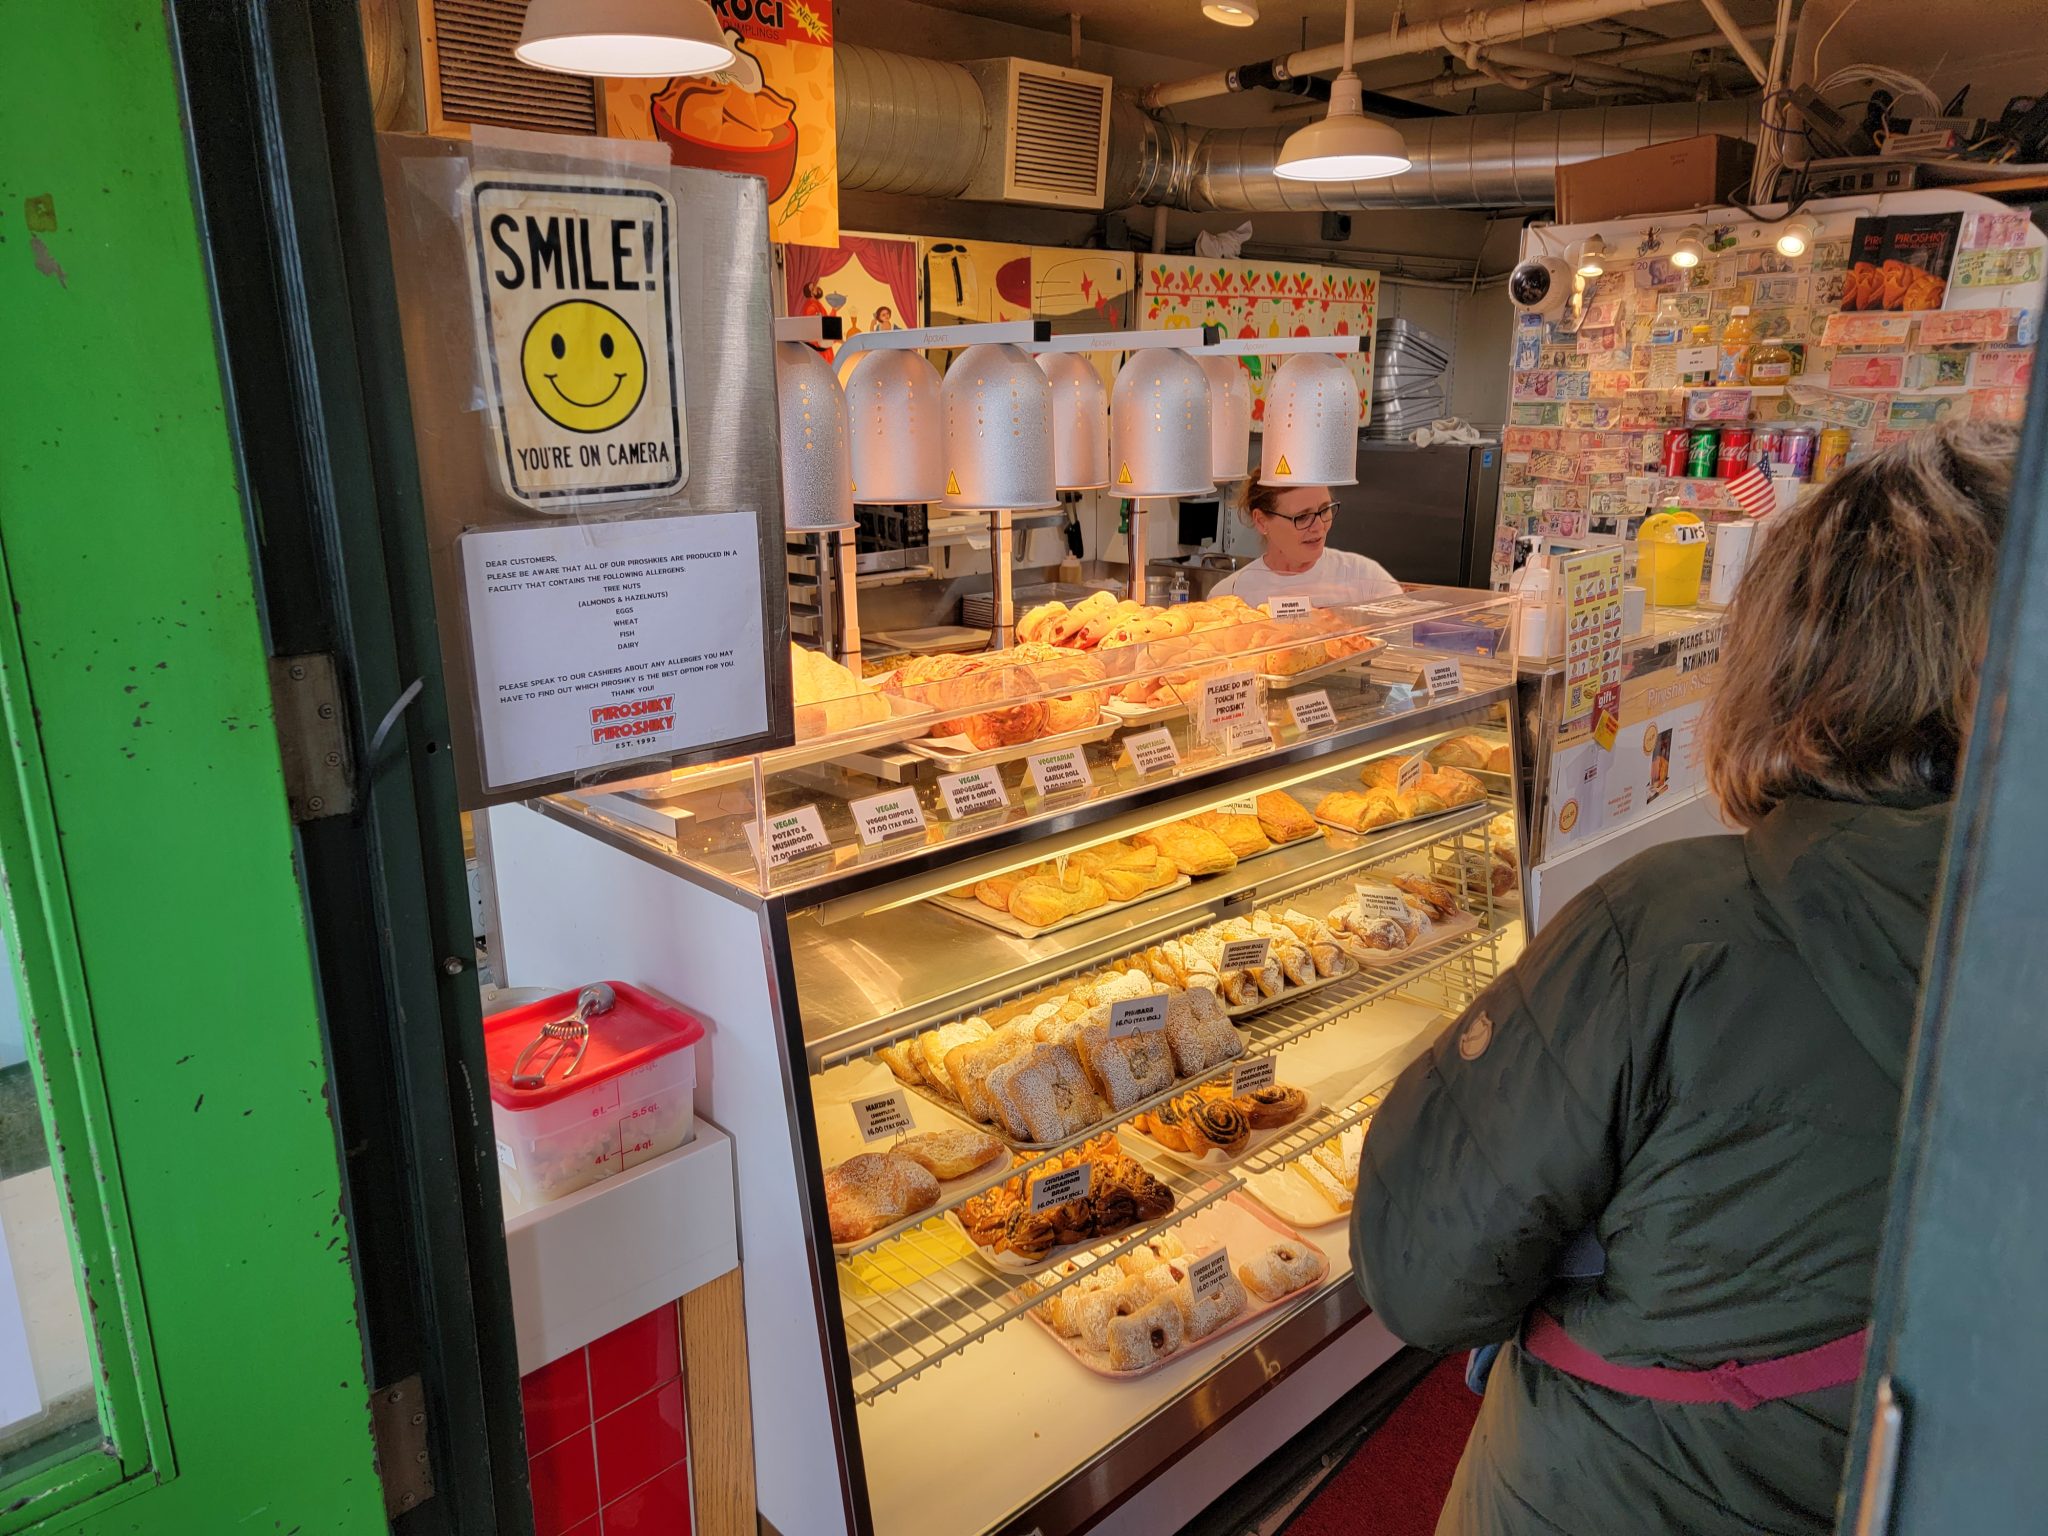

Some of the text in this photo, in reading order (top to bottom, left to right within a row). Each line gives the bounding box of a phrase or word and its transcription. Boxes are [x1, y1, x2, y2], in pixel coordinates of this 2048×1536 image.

[796, 7, 822, 34] NEW!
[490, 213, 656, 291] SMILE!
[517, 442, 670, 471] YOU'RE ON CAMERA
[1677, 525, 1706, 541] TIPS
[485, 556, 557, 568] DEAR CUSTOMERS,
[487, 571, 517, 580] PLEASE
[532, 567, 560, 576] AWARE
[627, 556, 668, 566] PIROSHKIES
[686, 551, 722, 561] PRODUCED
[488, 583, 523, 593] FACILITY
[525, 581, 546, 589] THAT
[548, 577, 586, 587] CONTAINS
[603, 571, 643, 581] FOLLOWING
[646, 567, 687, 576] ALLERGENS:
[604, 585, 620, 593] TREE
[578, 597, 616, 608] (ALMONDS
[625, 591, 668, 602] HAZELNUTS)
[613, 618, 639, 627] WHEAT
[619, 630, 635, 638] FISH
[1680, 627, 1723, 651] PLEASE EXIT
[617, 641, 639, 650] DAIRY
[1682, 650, 1707, 673] BEHIND
[499, 682, 528, 691] PLEASE
[530, 677, 555, 687] SPEAK
[570, 673, 586, 681] OUR
[588, 667, 622, 678] CASHIERS
[624, 663, 649, 672] ABOUT
[651, 660, 666, 668] ANY
[668, 655, 702, 665] ALLERGIES
[500, 695, 523, 703] HAVE
[538, 690, 555, 698] FIND
[575, 682, 599, 691] WHICH
[601, 676, 636, 687] PIROSHKY
[647, 672, 660, 680] THE
[661, 670, 678, 678] BEST
[680, 666, 704, 675] OPTION
[706, 663, 718, 671] FOR
[1207, 678, 1254, 695] PLEASE DO NOT
[611, 688, 635, 697] THANK
[1214, 691, 1248, 705] TOUCH THE
[592, 697, 673, 723] PIROSHKY
[593, 716, 674, 742] PIROSHKY
[615, 741, 634, 749] EST.
[1038, 752, 1075, 765] VEGETARIAN
[1046, 762, 1072, 773] CHEDDAR
[958, 774, 980, 785] VEGAN
[1044, 769, 1080, 782] GARLIC ROLL
[954, 795, 970, 805] BEEF
[976, 788, 997, 798] ONION
[875, 802, 899, 814] VEGAN
[773, 817, 798, 830] VEGAN
[866, 808, 914, 825] VEGGIE CHIPOTLE
[772, 827, 800, 842] POTATO
[868, 824, 887, 835] $7.00
[888, 821, 902, 830] (TAX
[772, 833, 814, 852] MUSHROOM
[1241, 1067, 1256, 1076] POPPY
[865, 1098, 895, 1112] MARZIPAN
[1043, 1177, 1080, 1193] CARDAMOM
[1045, 1170, 1080, 1185] CINNAMON
[1051, 1187, 1071, 1197] BRAID
[1055, 1195, 1068, 1203] (TAX
[1199, 1265, 1223, 1282] CHOCOLATE
